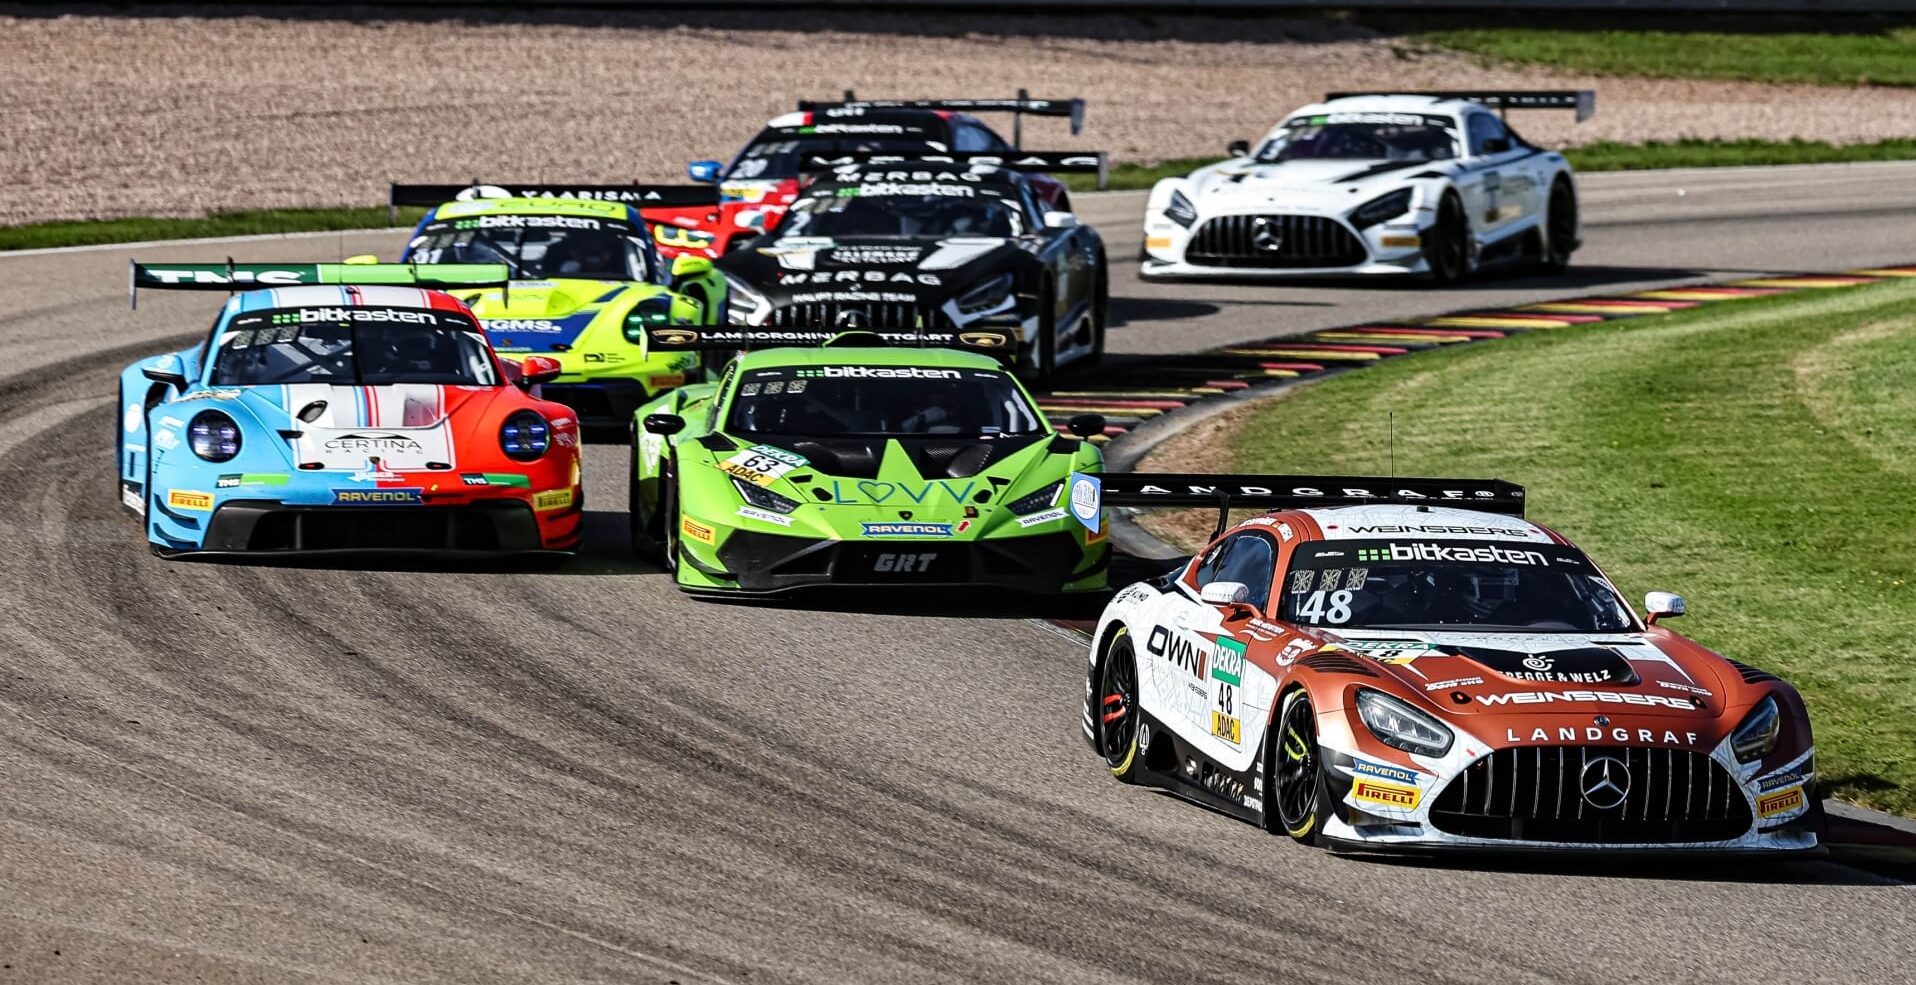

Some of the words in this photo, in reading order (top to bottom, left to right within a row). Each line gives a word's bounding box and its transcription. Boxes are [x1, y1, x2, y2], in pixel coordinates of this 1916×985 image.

[837, 171, 981, 182] MERBAG
[860, 182, 975, 197] bitkasten
[479, 214, 601, 230] bitkasten
[147, 269, 307, 284] TMS
[779, 270, 942, 286] MERBAG
[300, 308, 438, 325] bitkasten
[823, 366, 962, 380] bitkasten
[324, 440, 423, 449] CERTINA
[743, 454, 780, 473] 63
[726, 464, 764, 483] ADAC
[171, 492, 209, 508] PIRELLI
[338, 491, 416, 501] RAVENOL
[1022, 511, 1064, 525] RAVENOL
[868, 525, 948, 534] RAVENOL
[1348, 524, 1529, 537] WEINSBERG
[873, 552, 938, 573] GRT
[1389, 542, 1550, 567] bitkasten
[1300, 589, 1354, 625] 48
[1213, 643, 1243, 678] DEKRA
[1557, 671, 1569, 683] &
[1570, 669, 1612, 683] WELZ
[1217, 681, 1234, 716] 48
[1475, 690, 1697, 711] WEINSBERG
[1215, 714, 1236, 741] ADAC
[1506, 726, 1697, 746] LANDGRAF
[1357, 762, 1415, 781] RAVENOL
[1357, 782, 1415, 805] PIRELLI
[1759, 790, 1799, 814] PIRELLI
